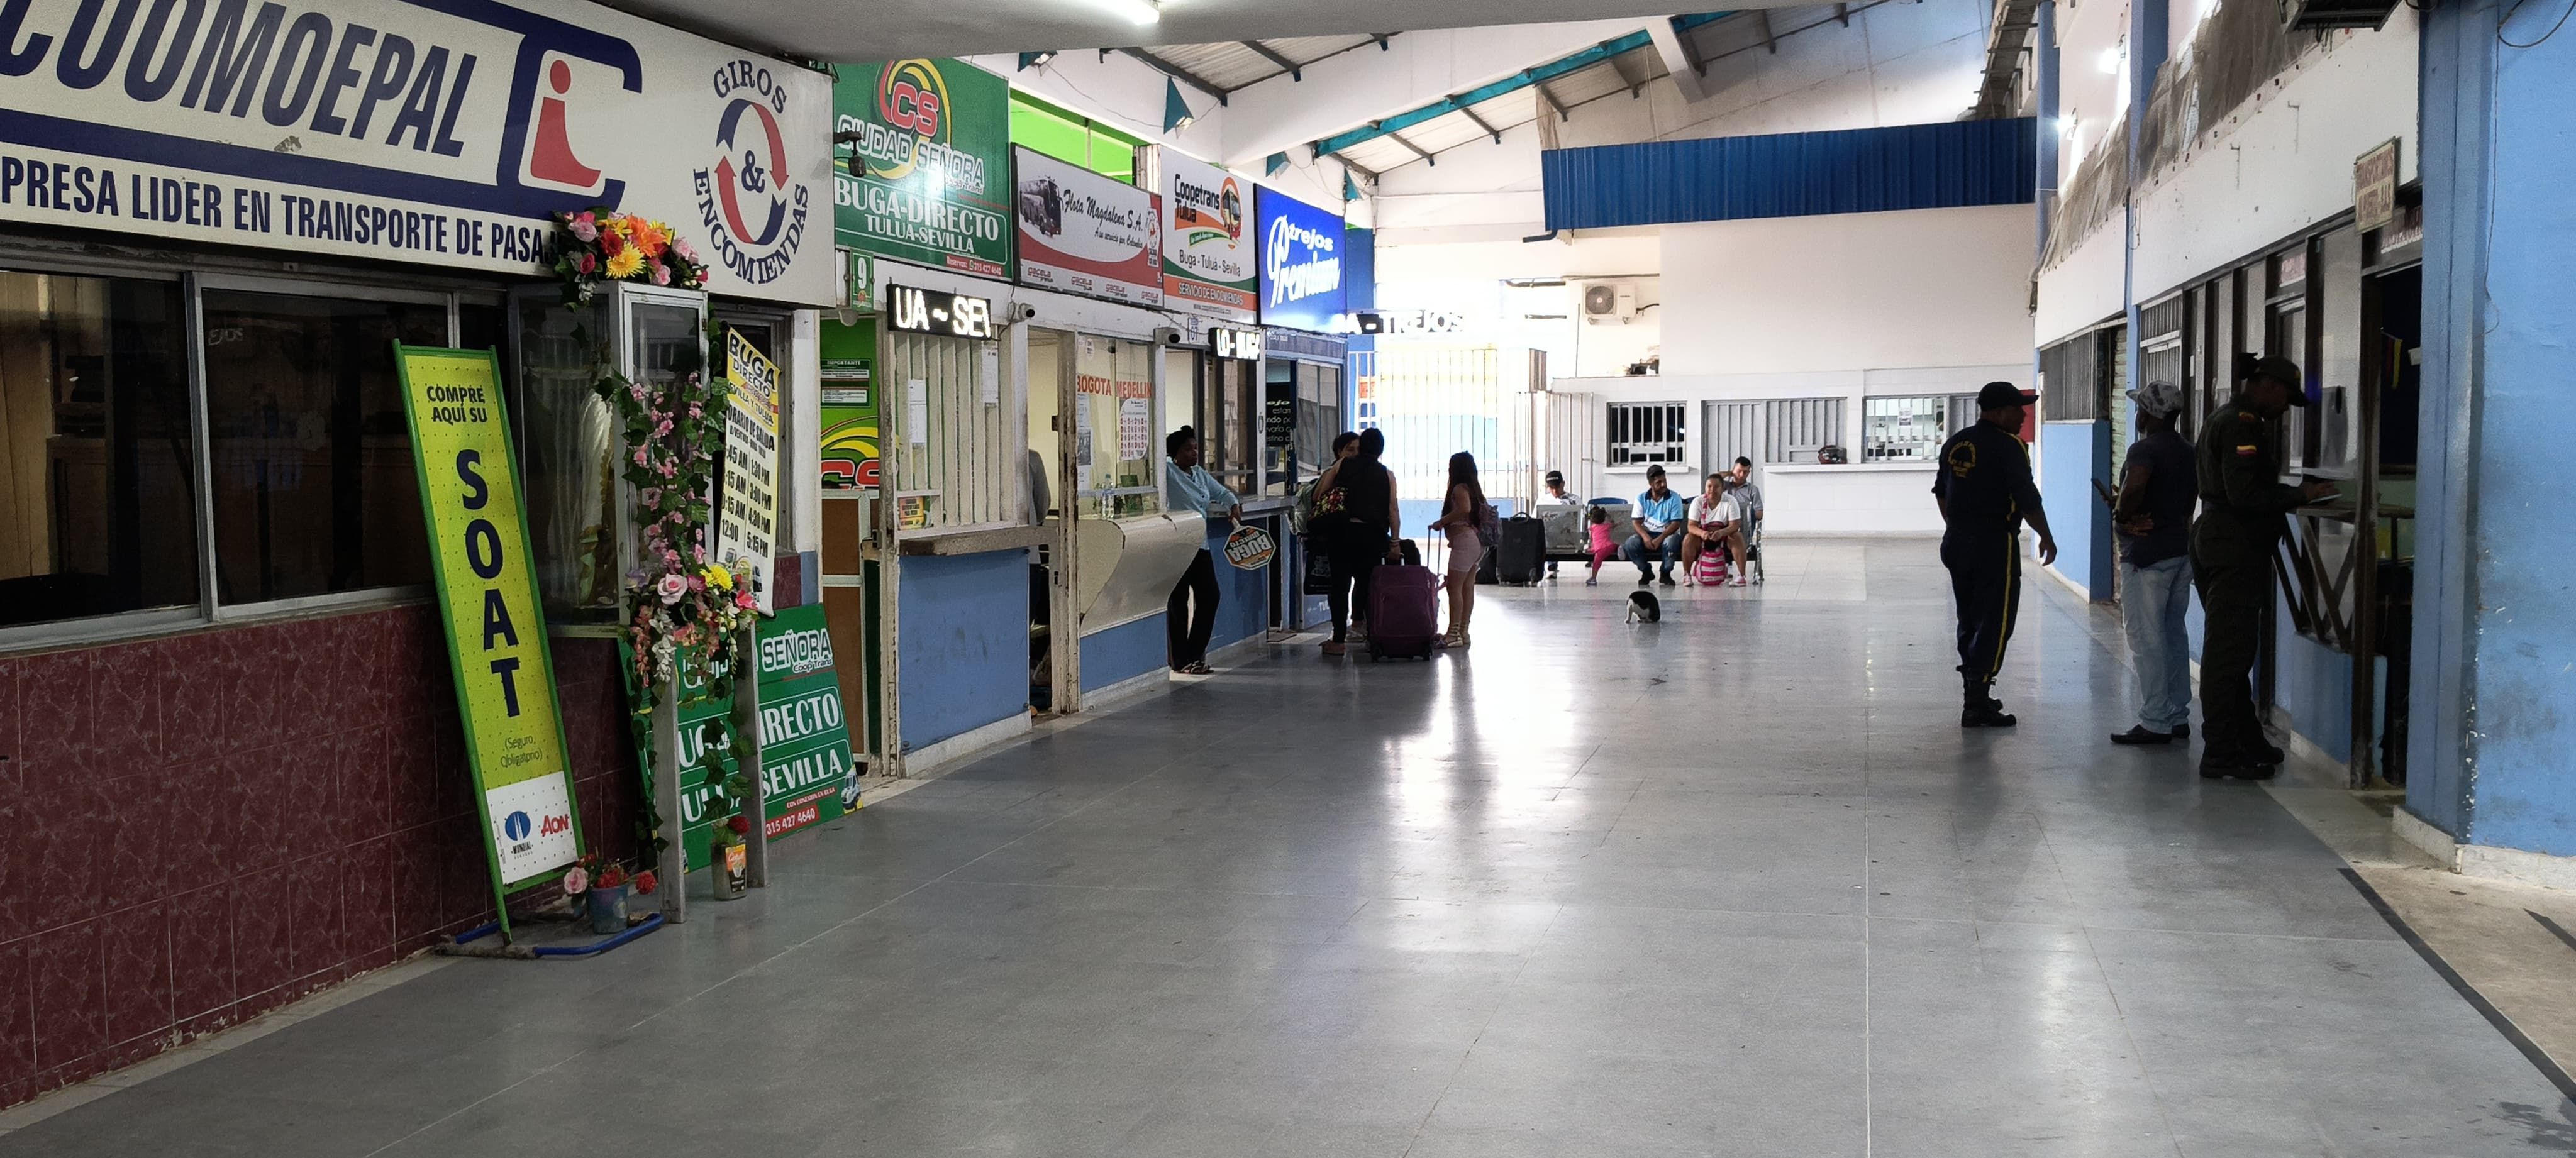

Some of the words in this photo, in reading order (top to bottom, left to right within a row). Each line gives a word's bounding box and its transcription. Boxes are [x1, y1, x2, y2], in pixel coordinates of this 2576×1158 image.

[714, 60, 787, 114] GIROS
[891, 82, 939, 136] CS
[916, 142, 985, 188] SEÑORA
[835, 176, 999, 241] BUGA-DIRECTO
[1063, 189, 1084, 214] Flota
[1087, 196, 1125, 228] Magdalena
[1174, 173, 1220, 211] Coopetrans
[131, 174, 222, 228] LIDER
[233, 188, 270, 233] EN
[280, 194, 448, 253] TRANSPORTE
[456, 218, 483, 257] DE
[694, 167, 809, 285] ENCOMIENDAS
[865, 213, 975, 253] TULUA-SEVILLA
[1289, 223, 1334, 252] trejos
[857, 256, 867, 289] 9
[1179, 248, 1196, 269] Buga
[896, 287, 930, 330] UA
[728, 333, 775, 390] BUGA
[733, 359, 770, 397] DIRECTO
[426, 385, 486, 404] COMPRE
[729, 382, 750, 405] EVILLA
[750, 397, 754, 408] Y
[755, 403, 774, 424] TULUA
[1077, 374, 1113, 396] BOGOTA
[1116, 380, 1152, 399] MEDELLIN
[470, 407, 488, 424] SU
[727, 404, 749, 430] ORARIO
[755, 423, 775, 452] SALIDA
[726, 444, 737, 465] :45
[738, 450, 748, 471] AM
[761, 465, 770, 487] PM
[724, 469, 735, 489] :15
[736, 473, 747, 495] AM
[761, 490, 772, 511] PM
[735, 499, 745, 521] AM
[760, 513, 770, 535] PM
[721, 518, 739, 543] 12:00
[747, 531, 759, 553] 5:15
[759, 537, 769, 559] PM
[1226, 534, 1272, 562] BUGA
[455, 448, 521, 718] SOAT
[760, 627, 833, 673] SEÑORA
[758, 692, 840, 747] IRECTO
[765, 820, 781, 835] 315
[782, 814, 796, 829] 427
[797, 808, 816, 824] 4640
